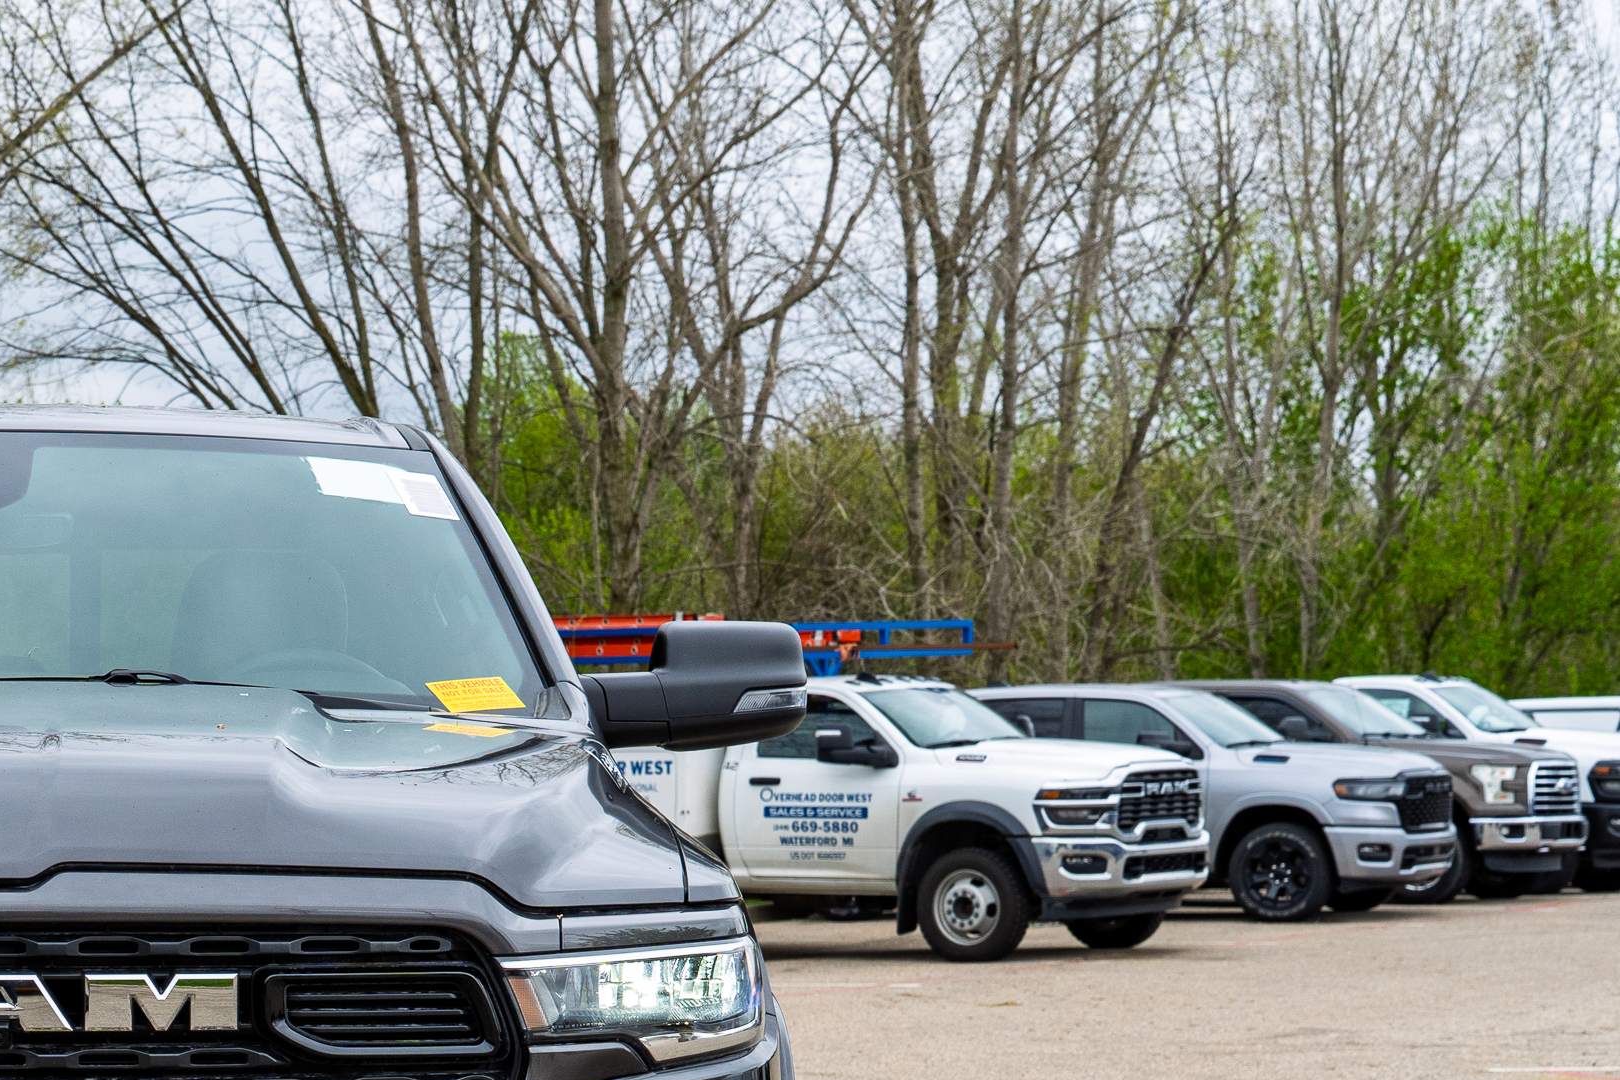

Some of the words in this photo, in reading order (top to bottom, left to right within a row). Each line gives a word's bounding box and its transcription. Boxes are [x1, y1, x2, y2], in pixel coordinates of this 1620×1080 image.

[432, 681, 458, 691] THIS
[457, 678, 503, 689] VEHICLE
[441, 690, 462, 698] NOT
[462, 688, 482, 696] FOR
[483, 686, 507, 694] SALE
[630, 760, 673, 776] WEST
[760, 787, 817, 802] OVERHEAD
[818, 793, 844, 802] DOOR
[846, 793, 873, 803] WEST
[1146, 781, 1189, 796] RAM
[769, 808, 804, 818] SALES
[806, 808, 815, 818] &
[816, 808, 863, 818] SERVICE
[791, 821, 859, 834] 669-5880
[779, 836, 838, 847] WATERFORD
[842, 837, 854, 847] MI
